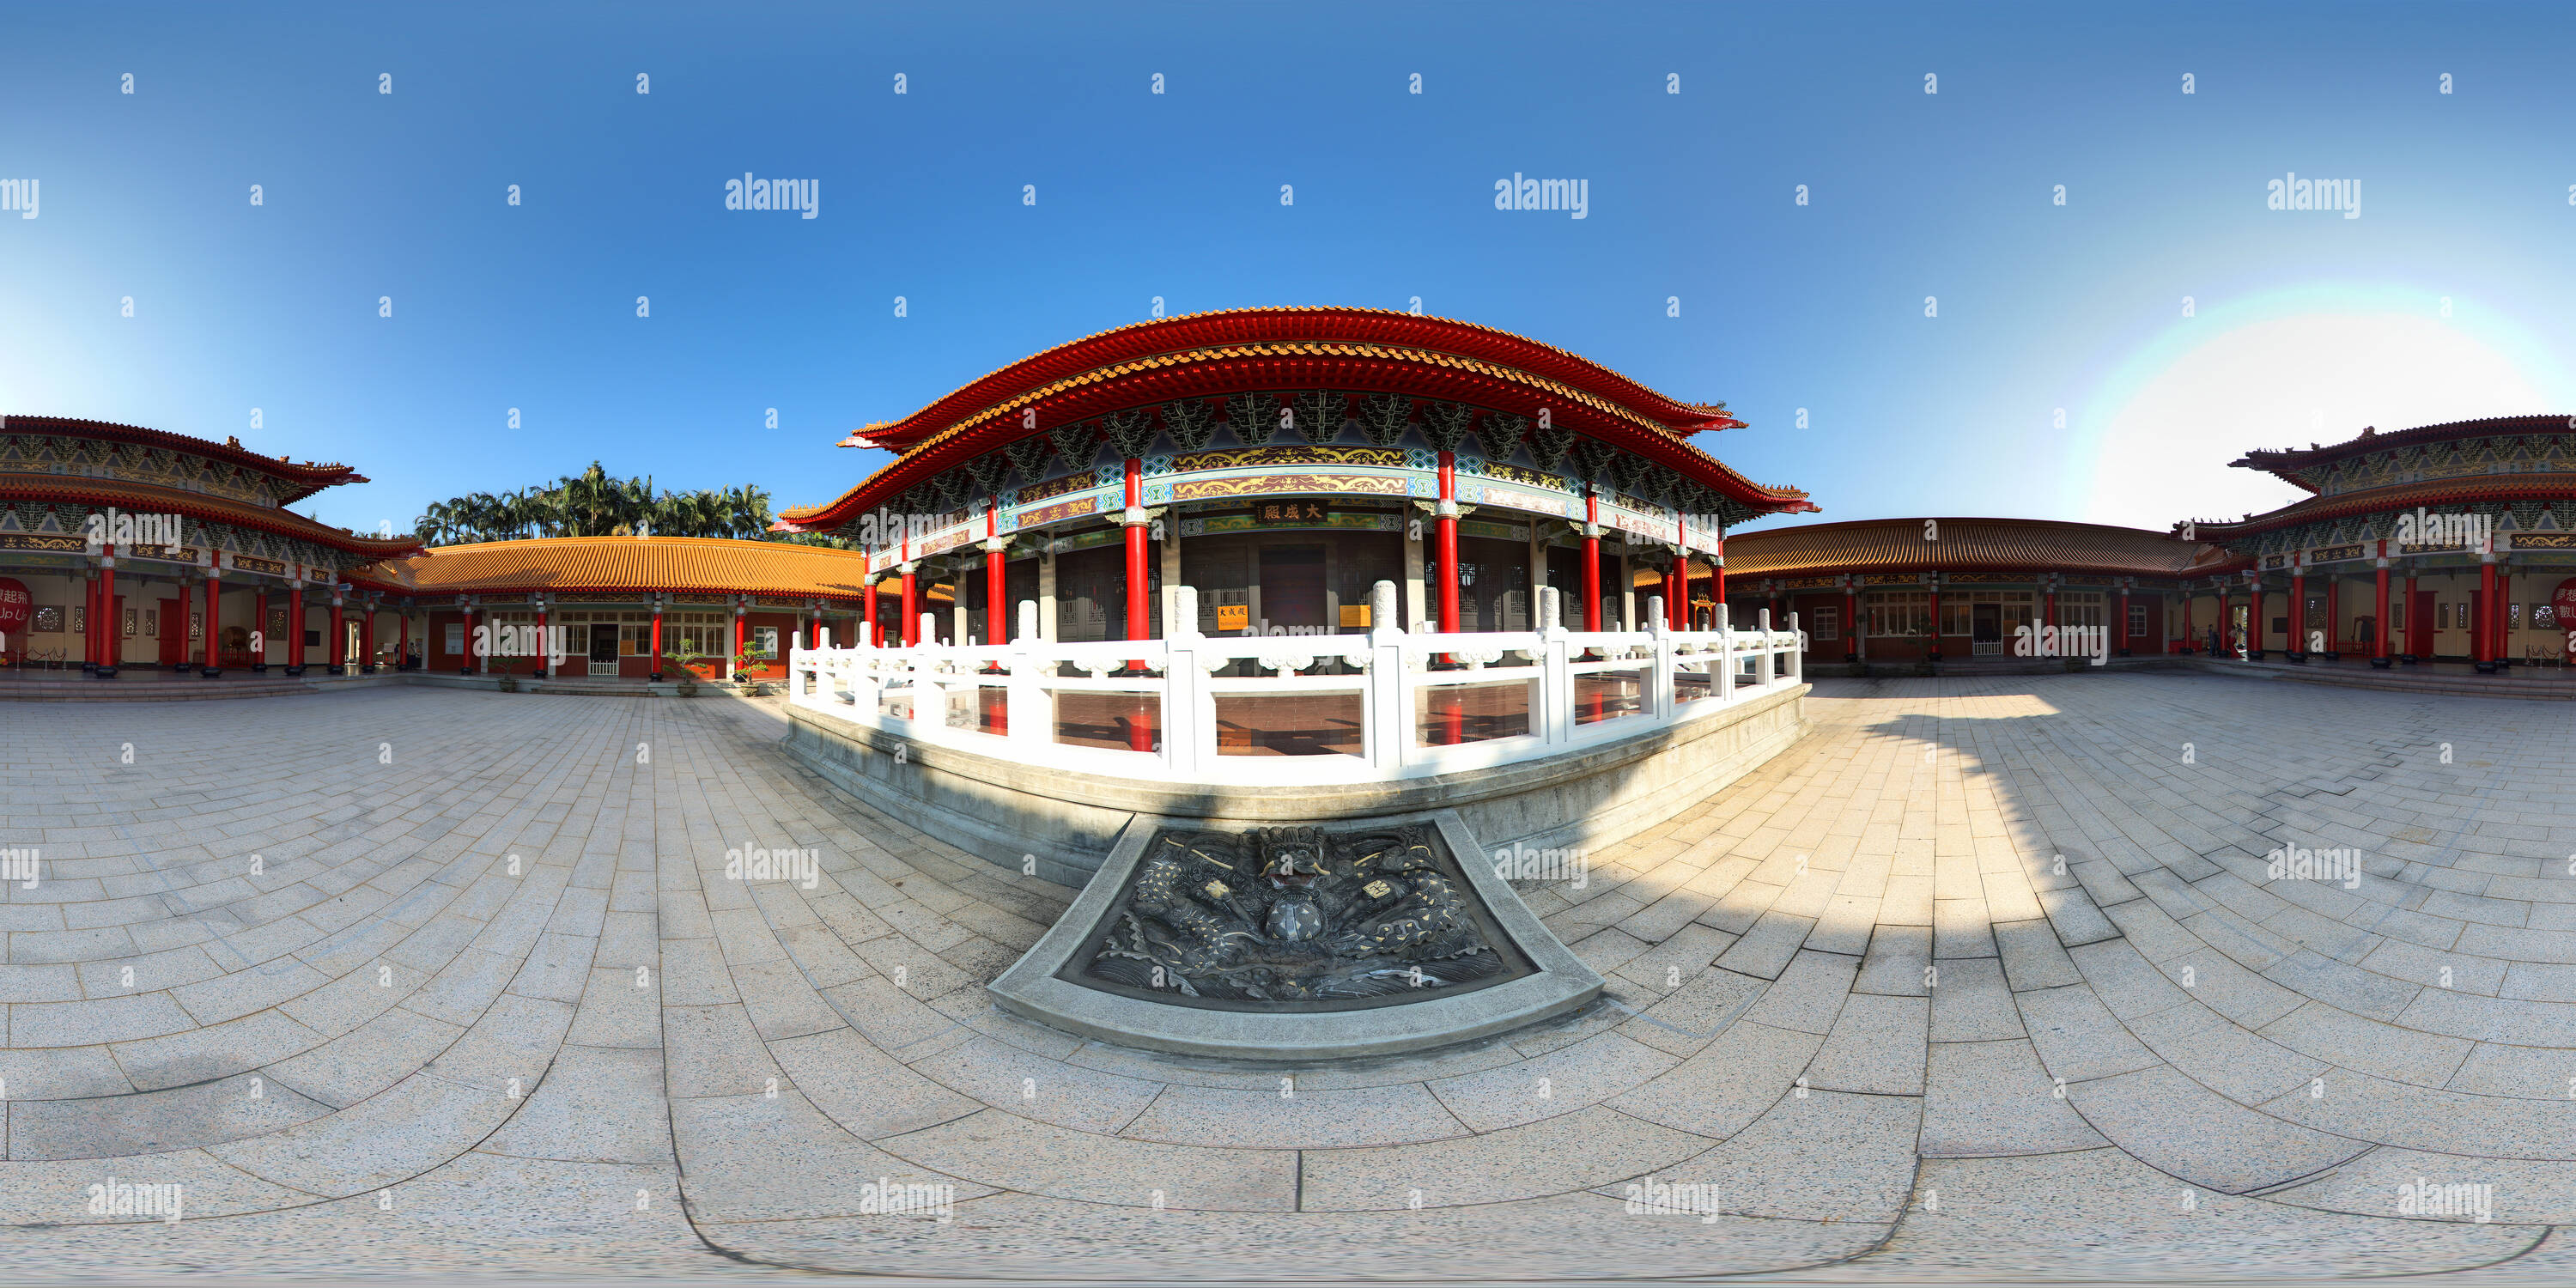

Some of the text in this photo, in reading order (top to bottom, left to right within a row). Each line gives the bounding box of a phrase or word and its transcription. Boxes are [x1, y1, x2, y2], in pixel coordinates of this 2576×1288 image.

[1264, 503, 1322, 519] 大成殿
[0, 589, 27, 605] 起飛
[1220, 607, 1246, 617] 大成殿
